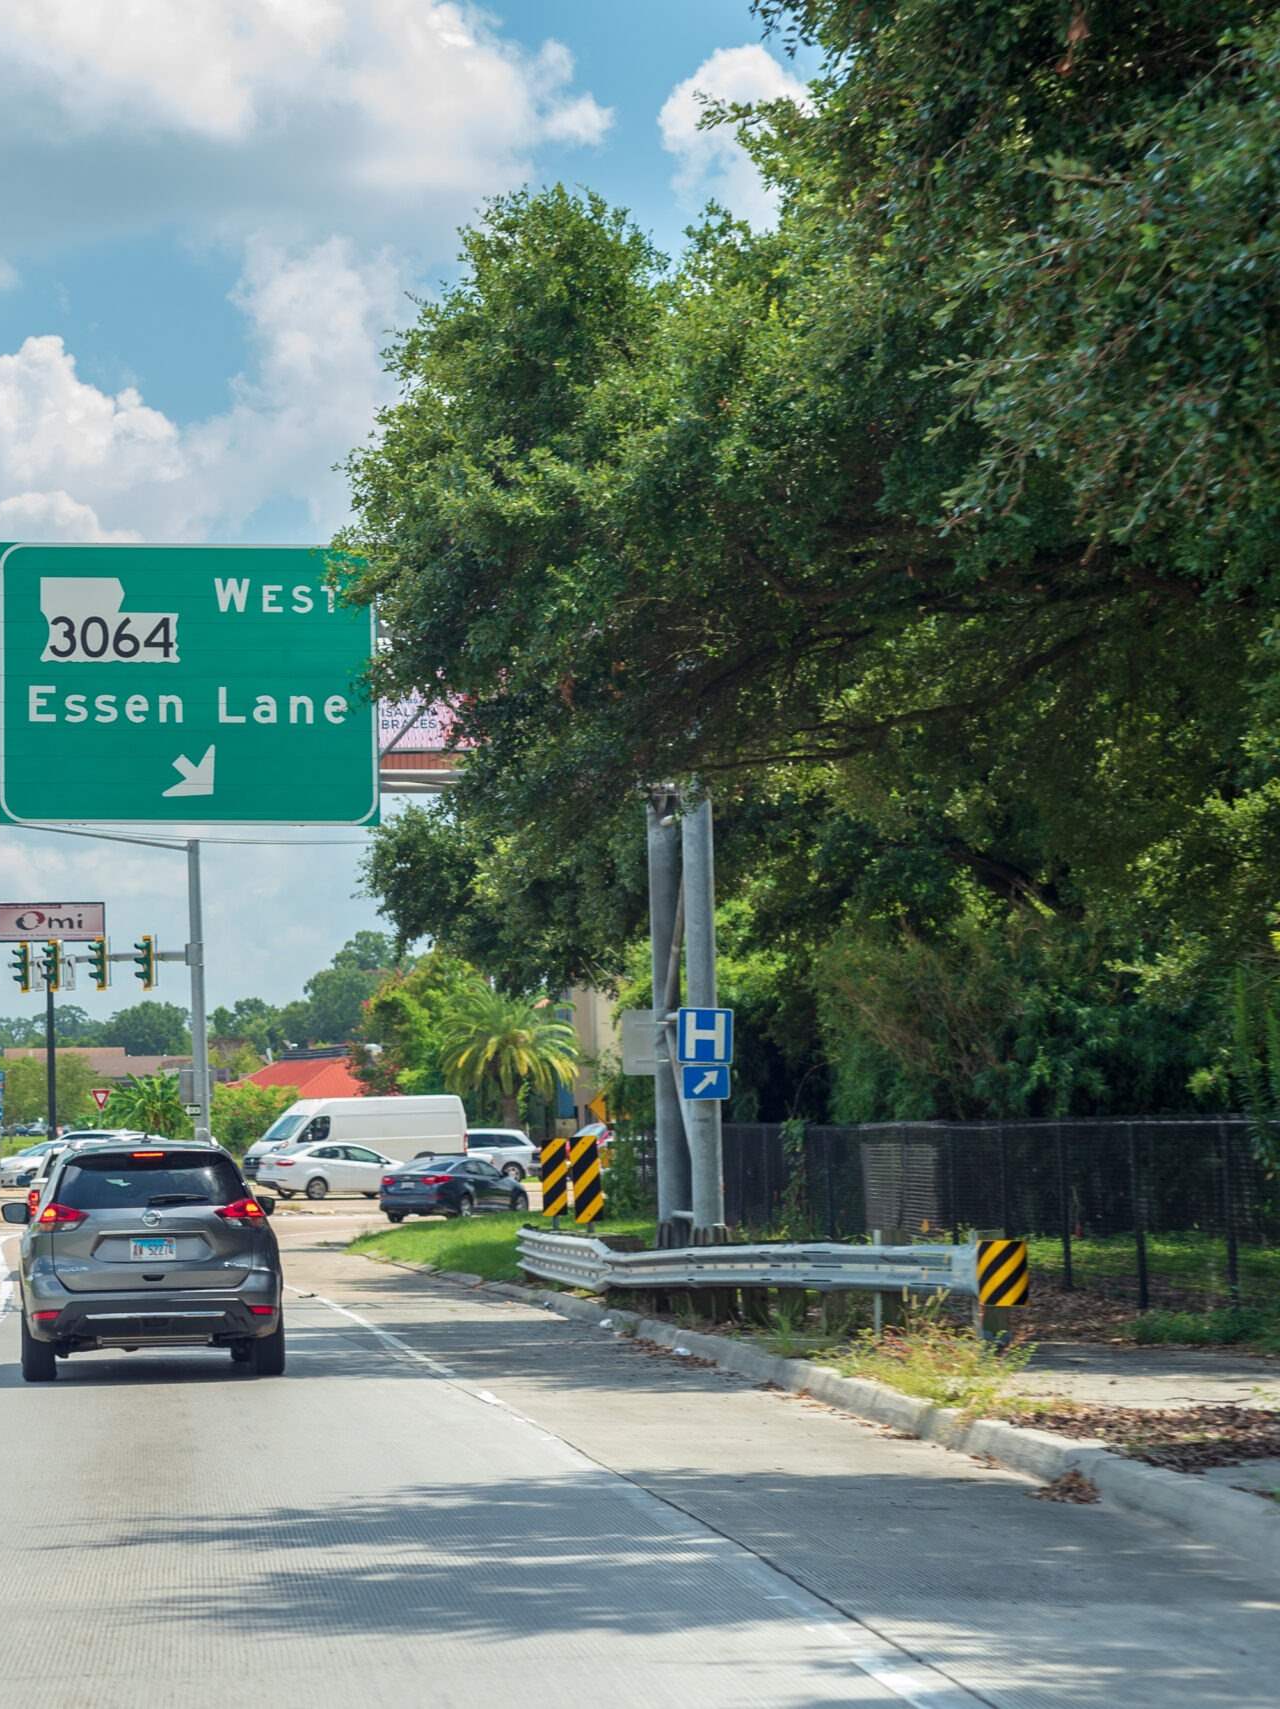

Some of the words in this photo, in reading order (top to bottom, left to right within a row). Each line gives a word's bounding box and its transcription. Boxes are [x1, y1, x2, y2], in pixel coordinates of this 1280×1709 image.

[214, 577, 342, 614] WEST
[49, 616, 175, 658] 3064
[28, 685, 184, 724] Essen
[217, 686, 348, 724] Lane
[15, 910, 83, 931] Omi
[685, 1011, 726, 1060] H
